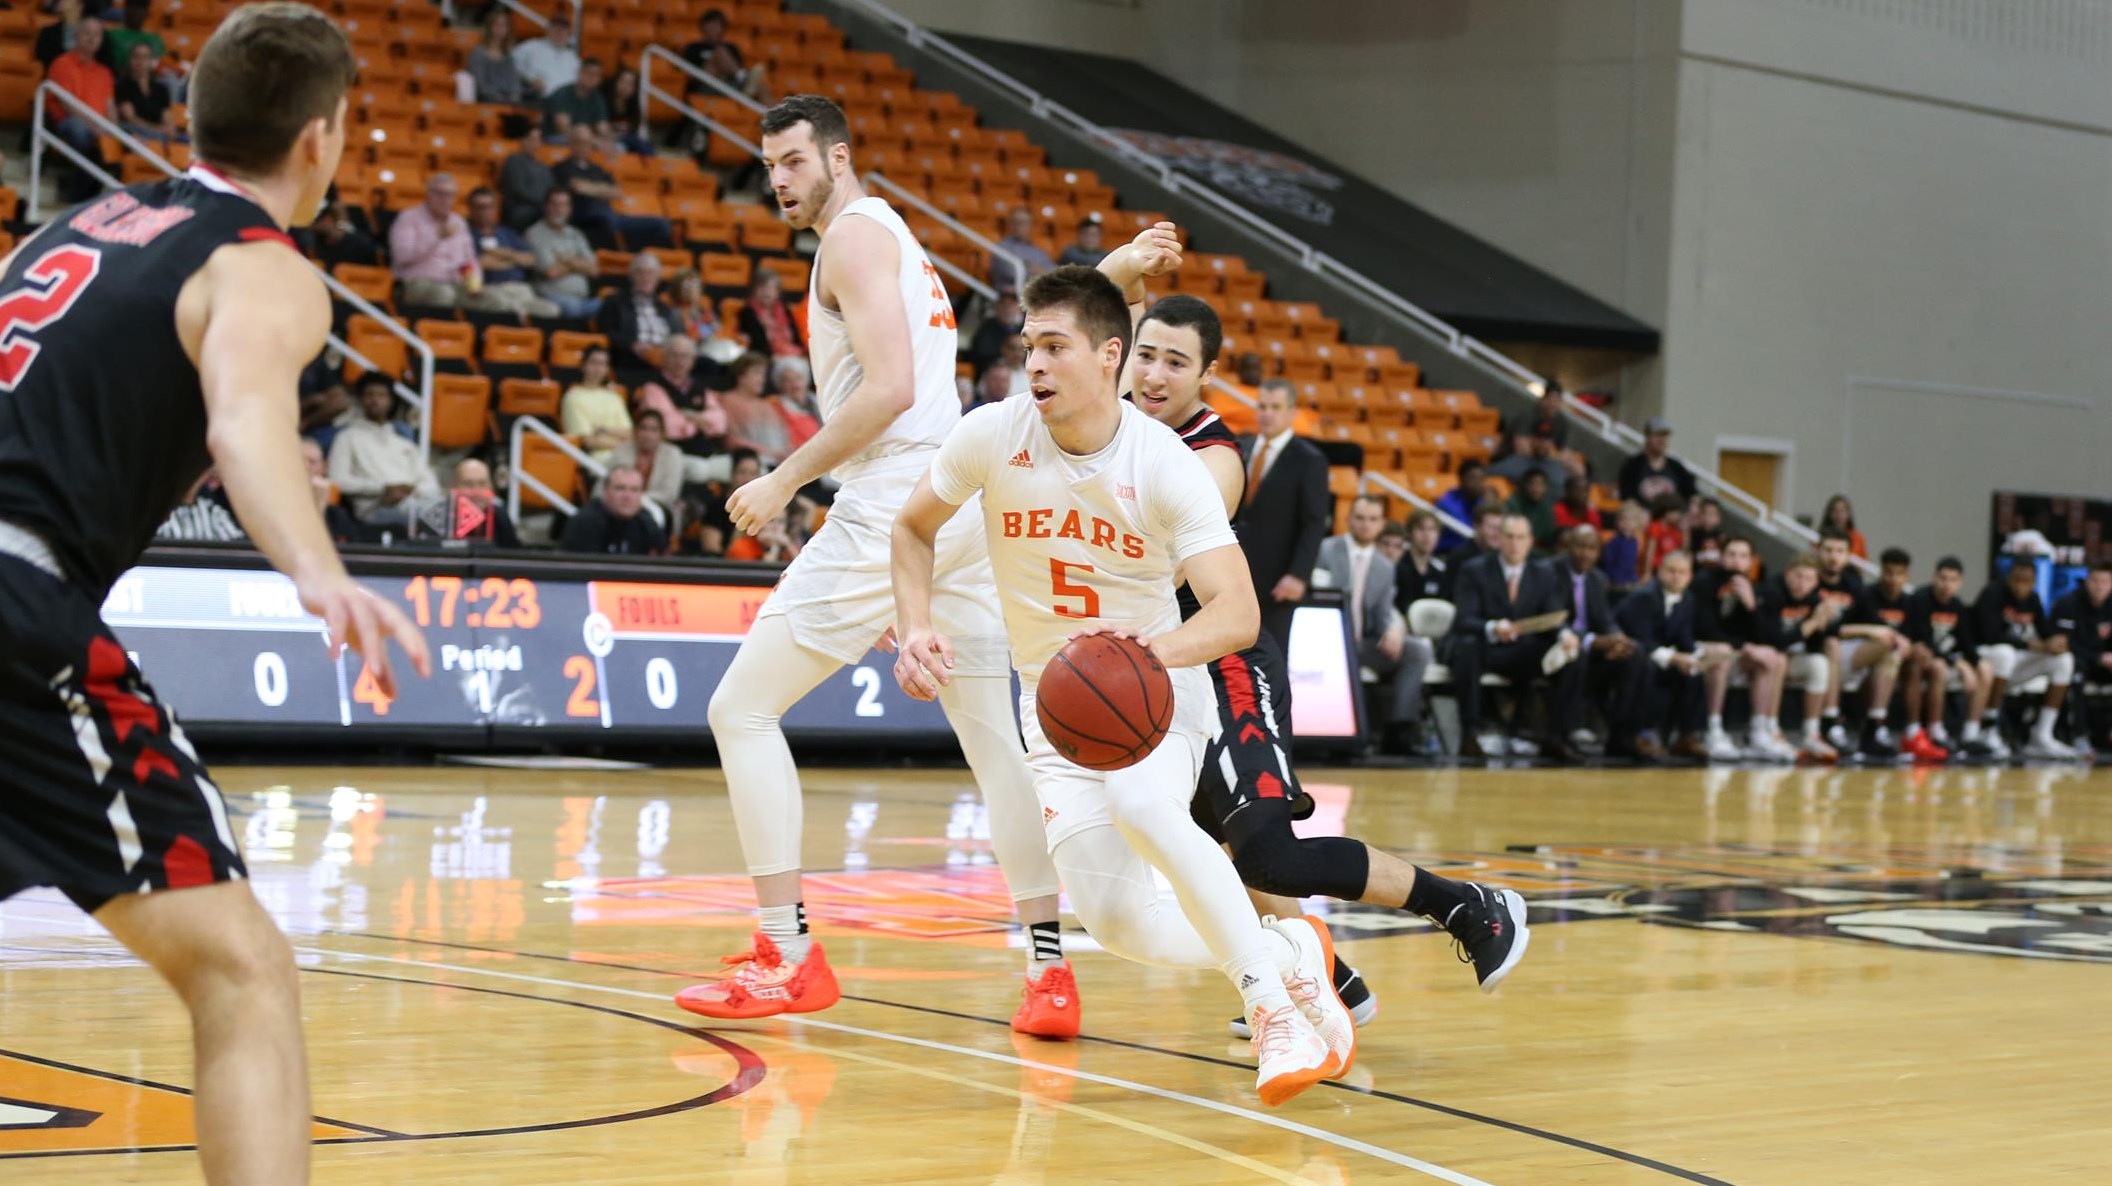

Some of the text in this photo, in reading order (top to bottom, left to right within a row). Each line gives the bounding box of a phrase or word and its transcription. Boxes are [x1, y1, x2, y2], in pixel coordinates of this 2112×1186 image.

[0, 243, 101, 392] 2
[1002, 508, 1144, 559] BEARS
[404, 575, 542, 629] 17:23
[618, 596, 681, 625] FOULS
[1049, 557, 1100, 619] 5
[253, 651, 288, 707] 0
[441, 644, 523, 671] Period
[645, 657, 678, 710] 0
[563, 655, 600, 717] 2
[851, 666, 885, 717] 2
